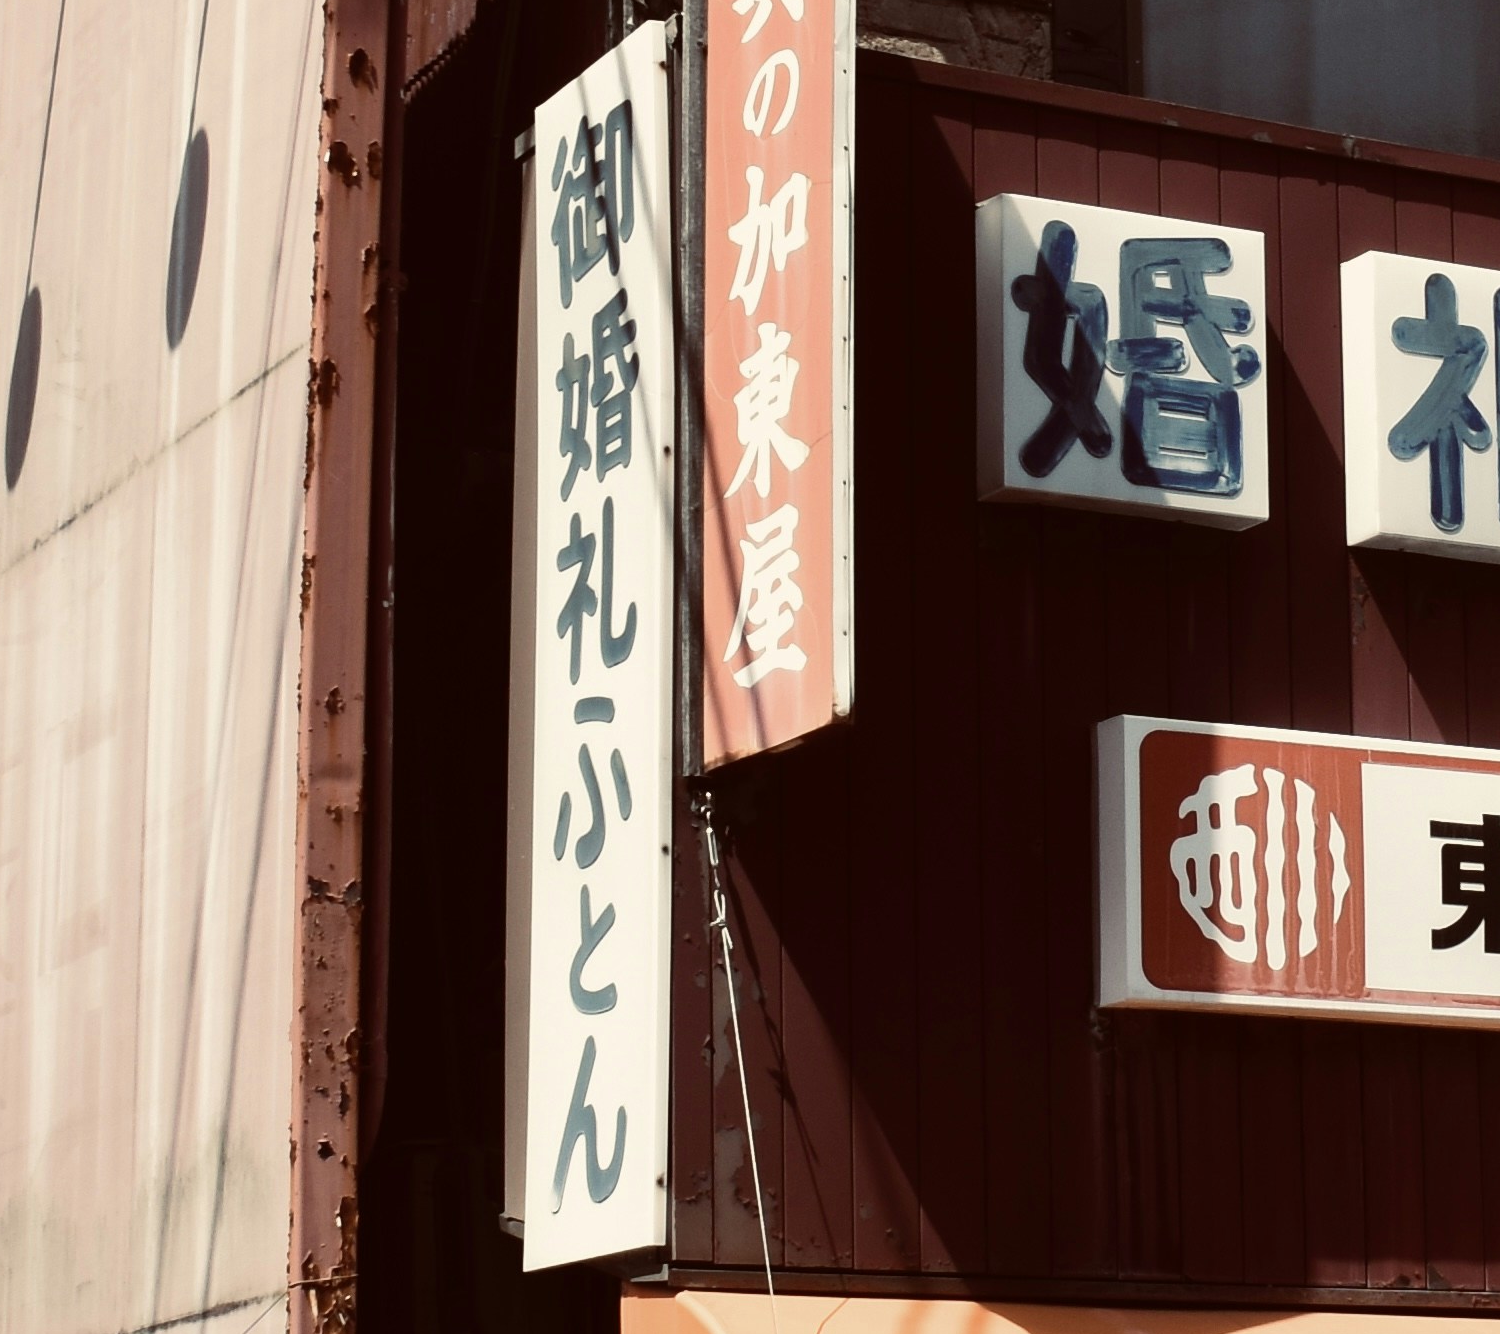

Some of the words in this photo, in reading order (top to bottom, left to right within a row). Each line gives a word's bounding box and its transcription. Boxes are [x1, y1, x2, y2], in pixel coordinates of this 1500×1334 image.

[550, 99, 638, 1213] 御婚礼ふとん
